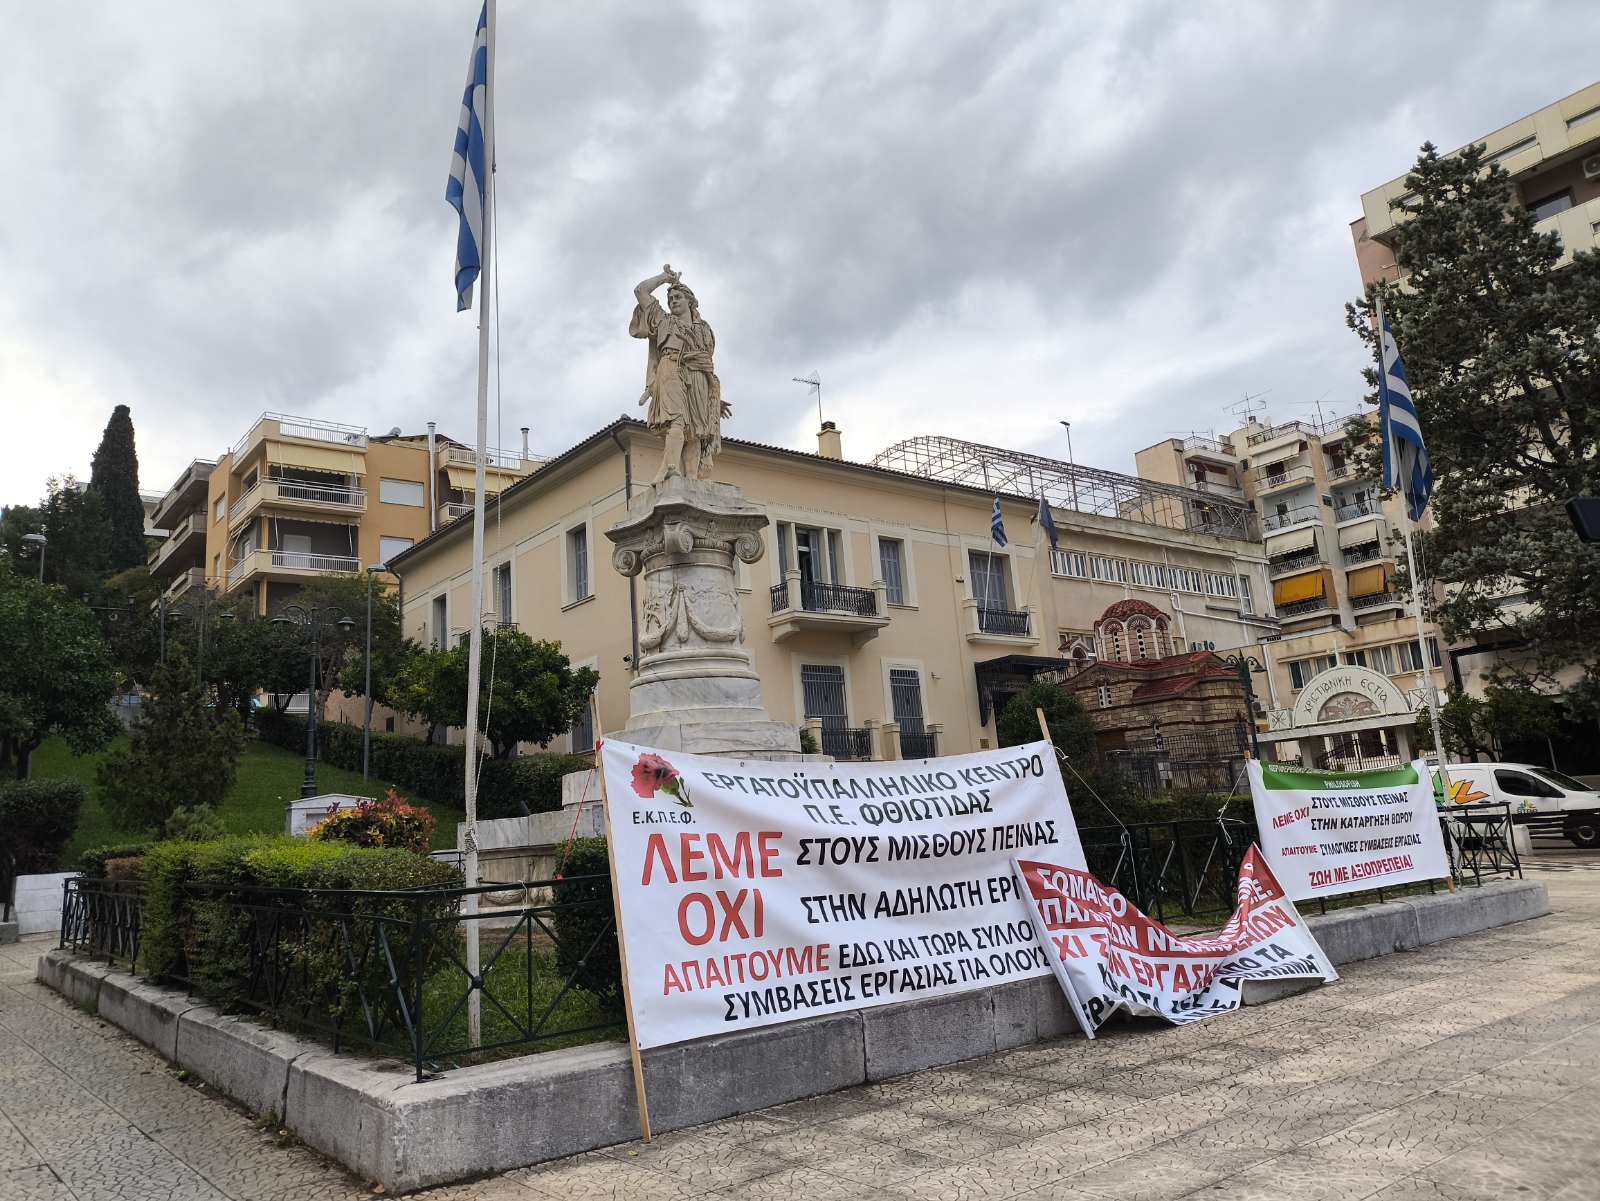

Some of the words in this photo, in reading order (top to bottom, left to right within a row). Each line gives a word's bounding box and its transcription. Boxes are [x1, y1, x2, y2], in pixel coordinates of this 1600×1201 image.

[701, 771, 957, 800] ΕΡΓΑΤΟΫΠΑΛΛΗΛΙΚΟ
[957, 754, 1044, 786] ΚΕΝΤΡΟ
[633, 811, 696, 825] Ε.Κ.Π.Ε.Φ.
[803, 804, 857, 826] Π.Ε.
[859, 789, 993, 826] ΦΘΙΩΤΙΔΑΣ
[1272, 810, 1296, 830] ΛΕΜΕ
[1294, 806, 1310, 822] ΟΧΙ
[1310, 817, 1338, 831] ΣΤΗΝ
[1340, 813, 1390, 830] ΚΑΤΑΡΓΗΣΗ
[1311, 796, 1339, 809] ΣΤΟΥΣ
[1339, 794, 1378, 808] ΜΙΣΘΟΥΣ
[1378, 791, 1409, 806] ΠΕΙΝΑΣ
[641, 831, 783, 886] ΛΕΜΕ
[797, 835, 880, 865] ΣΤΟΥΣ
[887, 828, 987, 861] ΜΙΣΘΟΥΣ
[991, 820, 1059, 851] ΠΕΙΝΑΣ
[1309, 871, 1332, 888] ΖΩΗ
[1334, 866, 1350, 882] ΜΕ
[677, 888, 764, 946] ΟΧΙ
[800, 893, 866, 924] ΣΤΗΝ
[873, 879, 983, 919] ΑΔΗΛΩΤΗ
[839, 941, 884, 969] ΕΔΩ
[884, 937, 919, 962] ΚΑΙ
[918, 930, 972, 957] ΤΩΡΑ
[971, 919, 1038, 949] ΣΥΛΛΟ
[663, 943, 830, 995] ΑΠΑΙΤΟΥΜΕ
[723, 976, 856, 1021] ΣΥΜΒΑΣΕΙΣ
[861, 961, 957, 998] ΕΡΓΑΣΙΑΣ
[957, 957, 990, 981] ΓΙΑ
[990, 946, 1051, 976] ΟΛΟΥΣ
